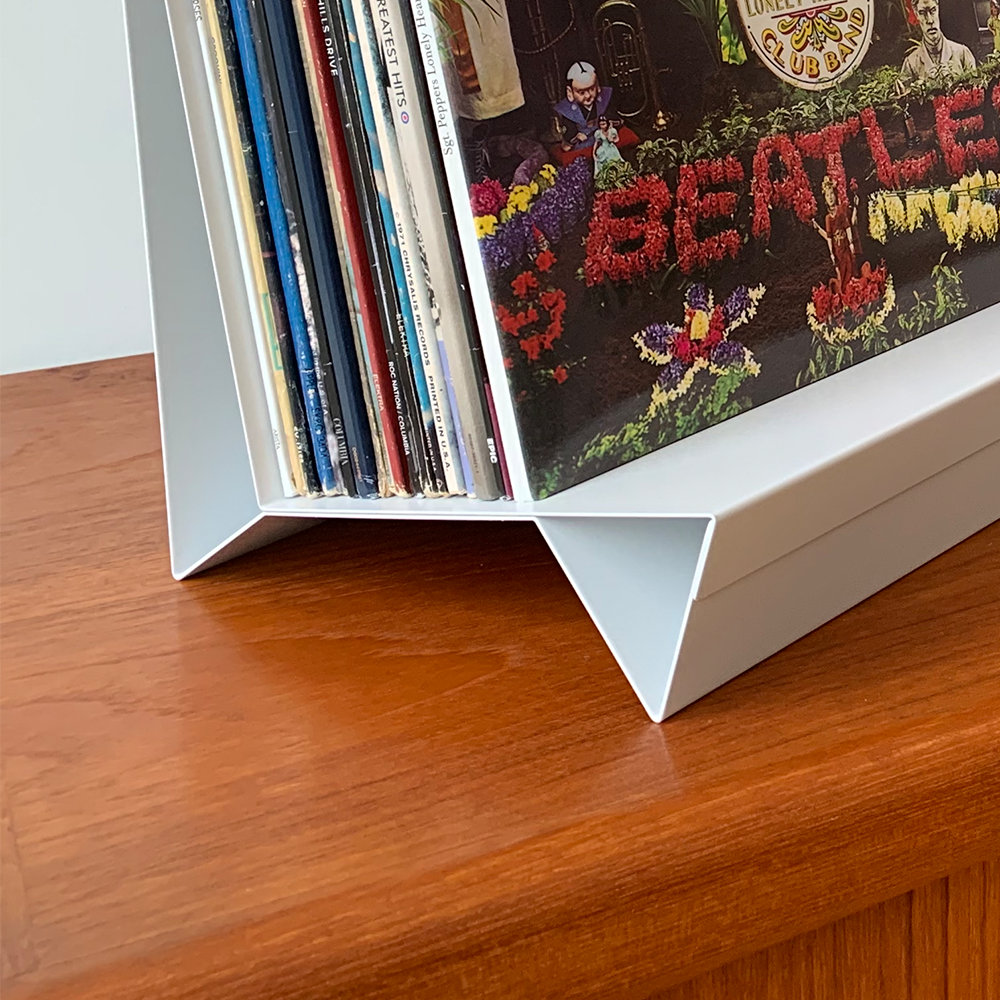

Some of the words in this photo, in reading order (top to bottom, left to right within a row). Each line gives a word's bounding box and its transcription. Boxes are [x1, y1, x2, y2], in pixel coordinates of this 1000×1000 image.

[324, 37, 338, 77] DRIVE
[420, 30, 437, 75] Lonely
[761, 28, 820, 78] CLUB
[824, 7, 865, 73] BAND
[391, 71, 406, 107] HITS
[429, 78, 448, 128] Peppers
[441, 131, 454, 156] Sgt.
[396, 222, 405, 246] 1971
[402, 249, 418, 311] CHRYSALIS
[415, 314, 429, 366] RECORDS
[427, 375, 441, 422] PRINTED
[437, 425, 444, 437] IN
[386, 360, 396, 379] ROC
[372, 372, 384, 411] ELEKTRA
[390, 379, 402, 409] NATION
[332, 417, 349, 465] COLUMBIA
[397, 414, 410, 455] COLUMBIA
[485, 437, 498, 464] EPIC
